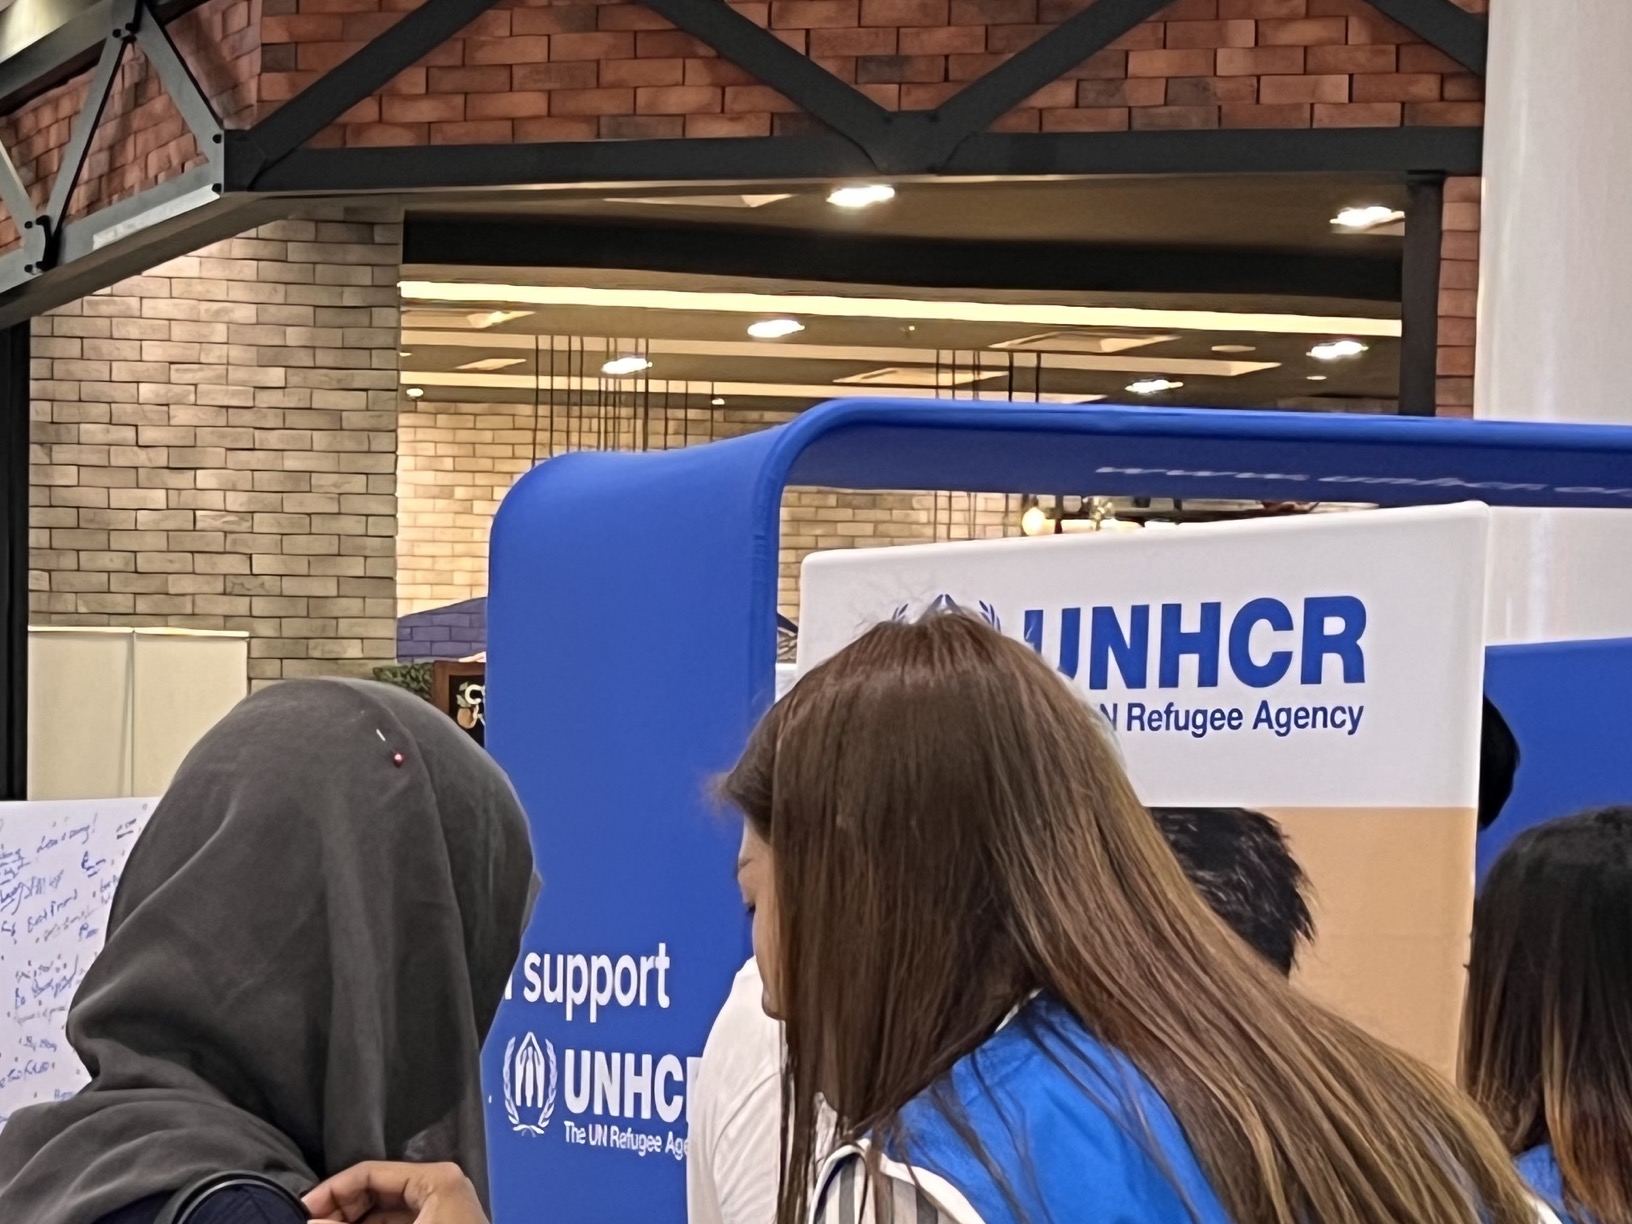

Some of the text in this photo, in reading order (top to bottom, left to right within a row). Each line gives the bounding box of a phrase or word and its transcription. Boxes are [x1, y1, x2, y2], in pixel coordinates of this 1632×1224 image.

[1024, 595, 1368, 691] UNHCR
[1126, 701, 1243, 738] Refugee
[1252, 699, 1365, 737] Agency
[523, 942, 670, 1023] support
[563, 1120, 587, 1144] The
[588, 1123, 608, 1147] UN
[610, 1125, 662, 1157] Refugee
